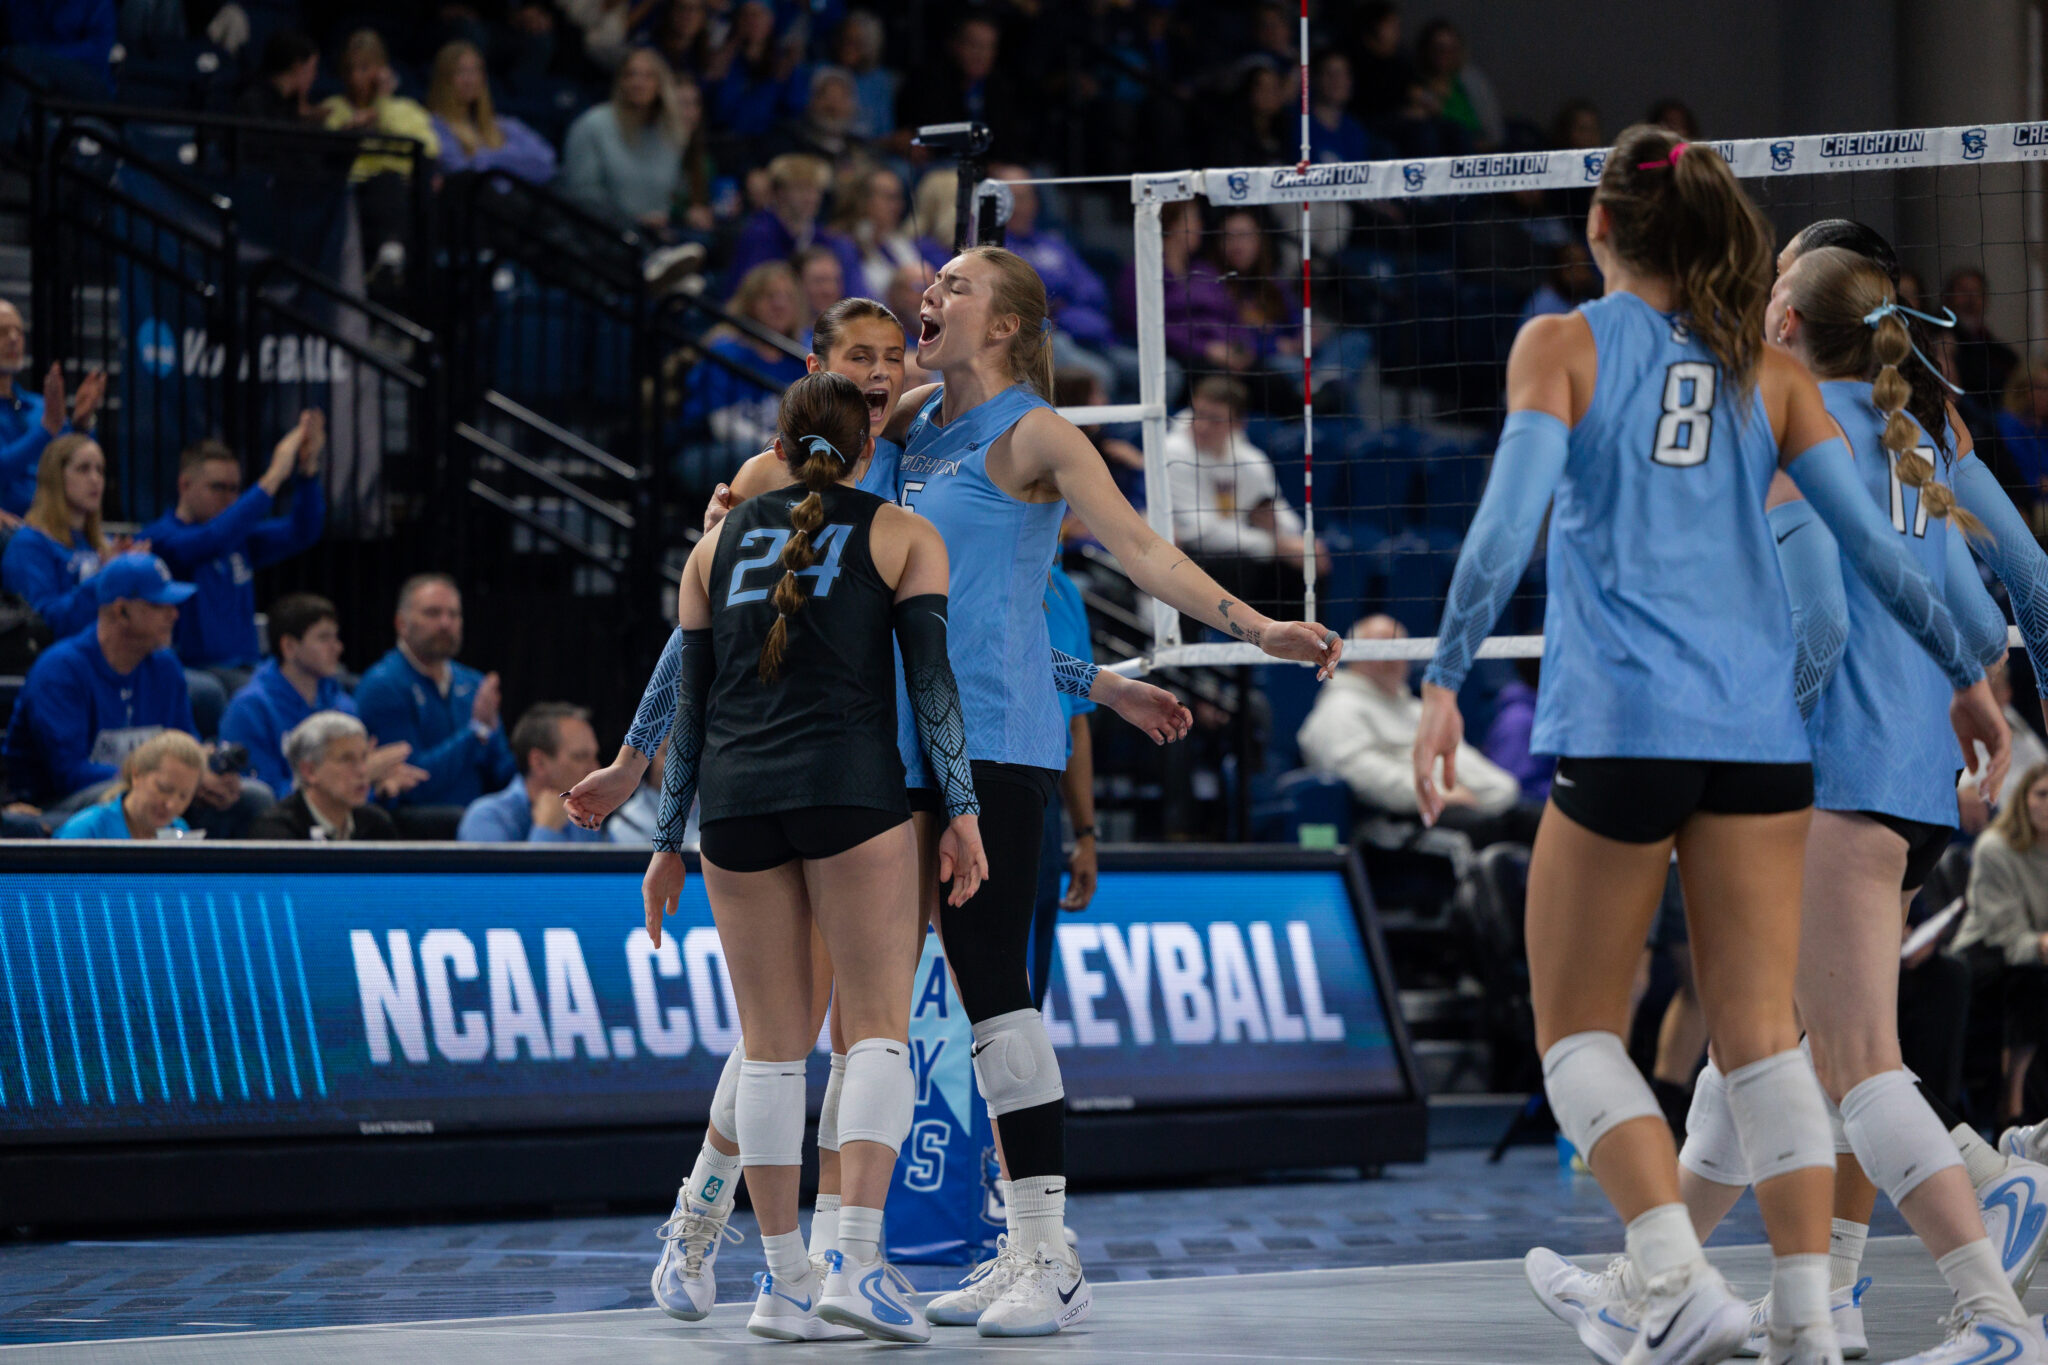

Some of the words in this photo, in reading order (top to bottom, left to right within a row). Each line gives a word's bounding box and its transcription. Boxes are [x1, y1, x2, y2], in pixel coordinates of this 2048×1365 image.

[1451, 154, 1549, 178] CREIGHTON
[1820, 132, 1925, 158] CREIGHTON
[1829, 156, 1917, 168] VOLLEYBALL
[1651, 361, 1716, 467] 8
[1886, 445, 1936, 539] 17
[725, 522, 855, 610] 24
[349, 926, 744, 1065] NCAA.CO
